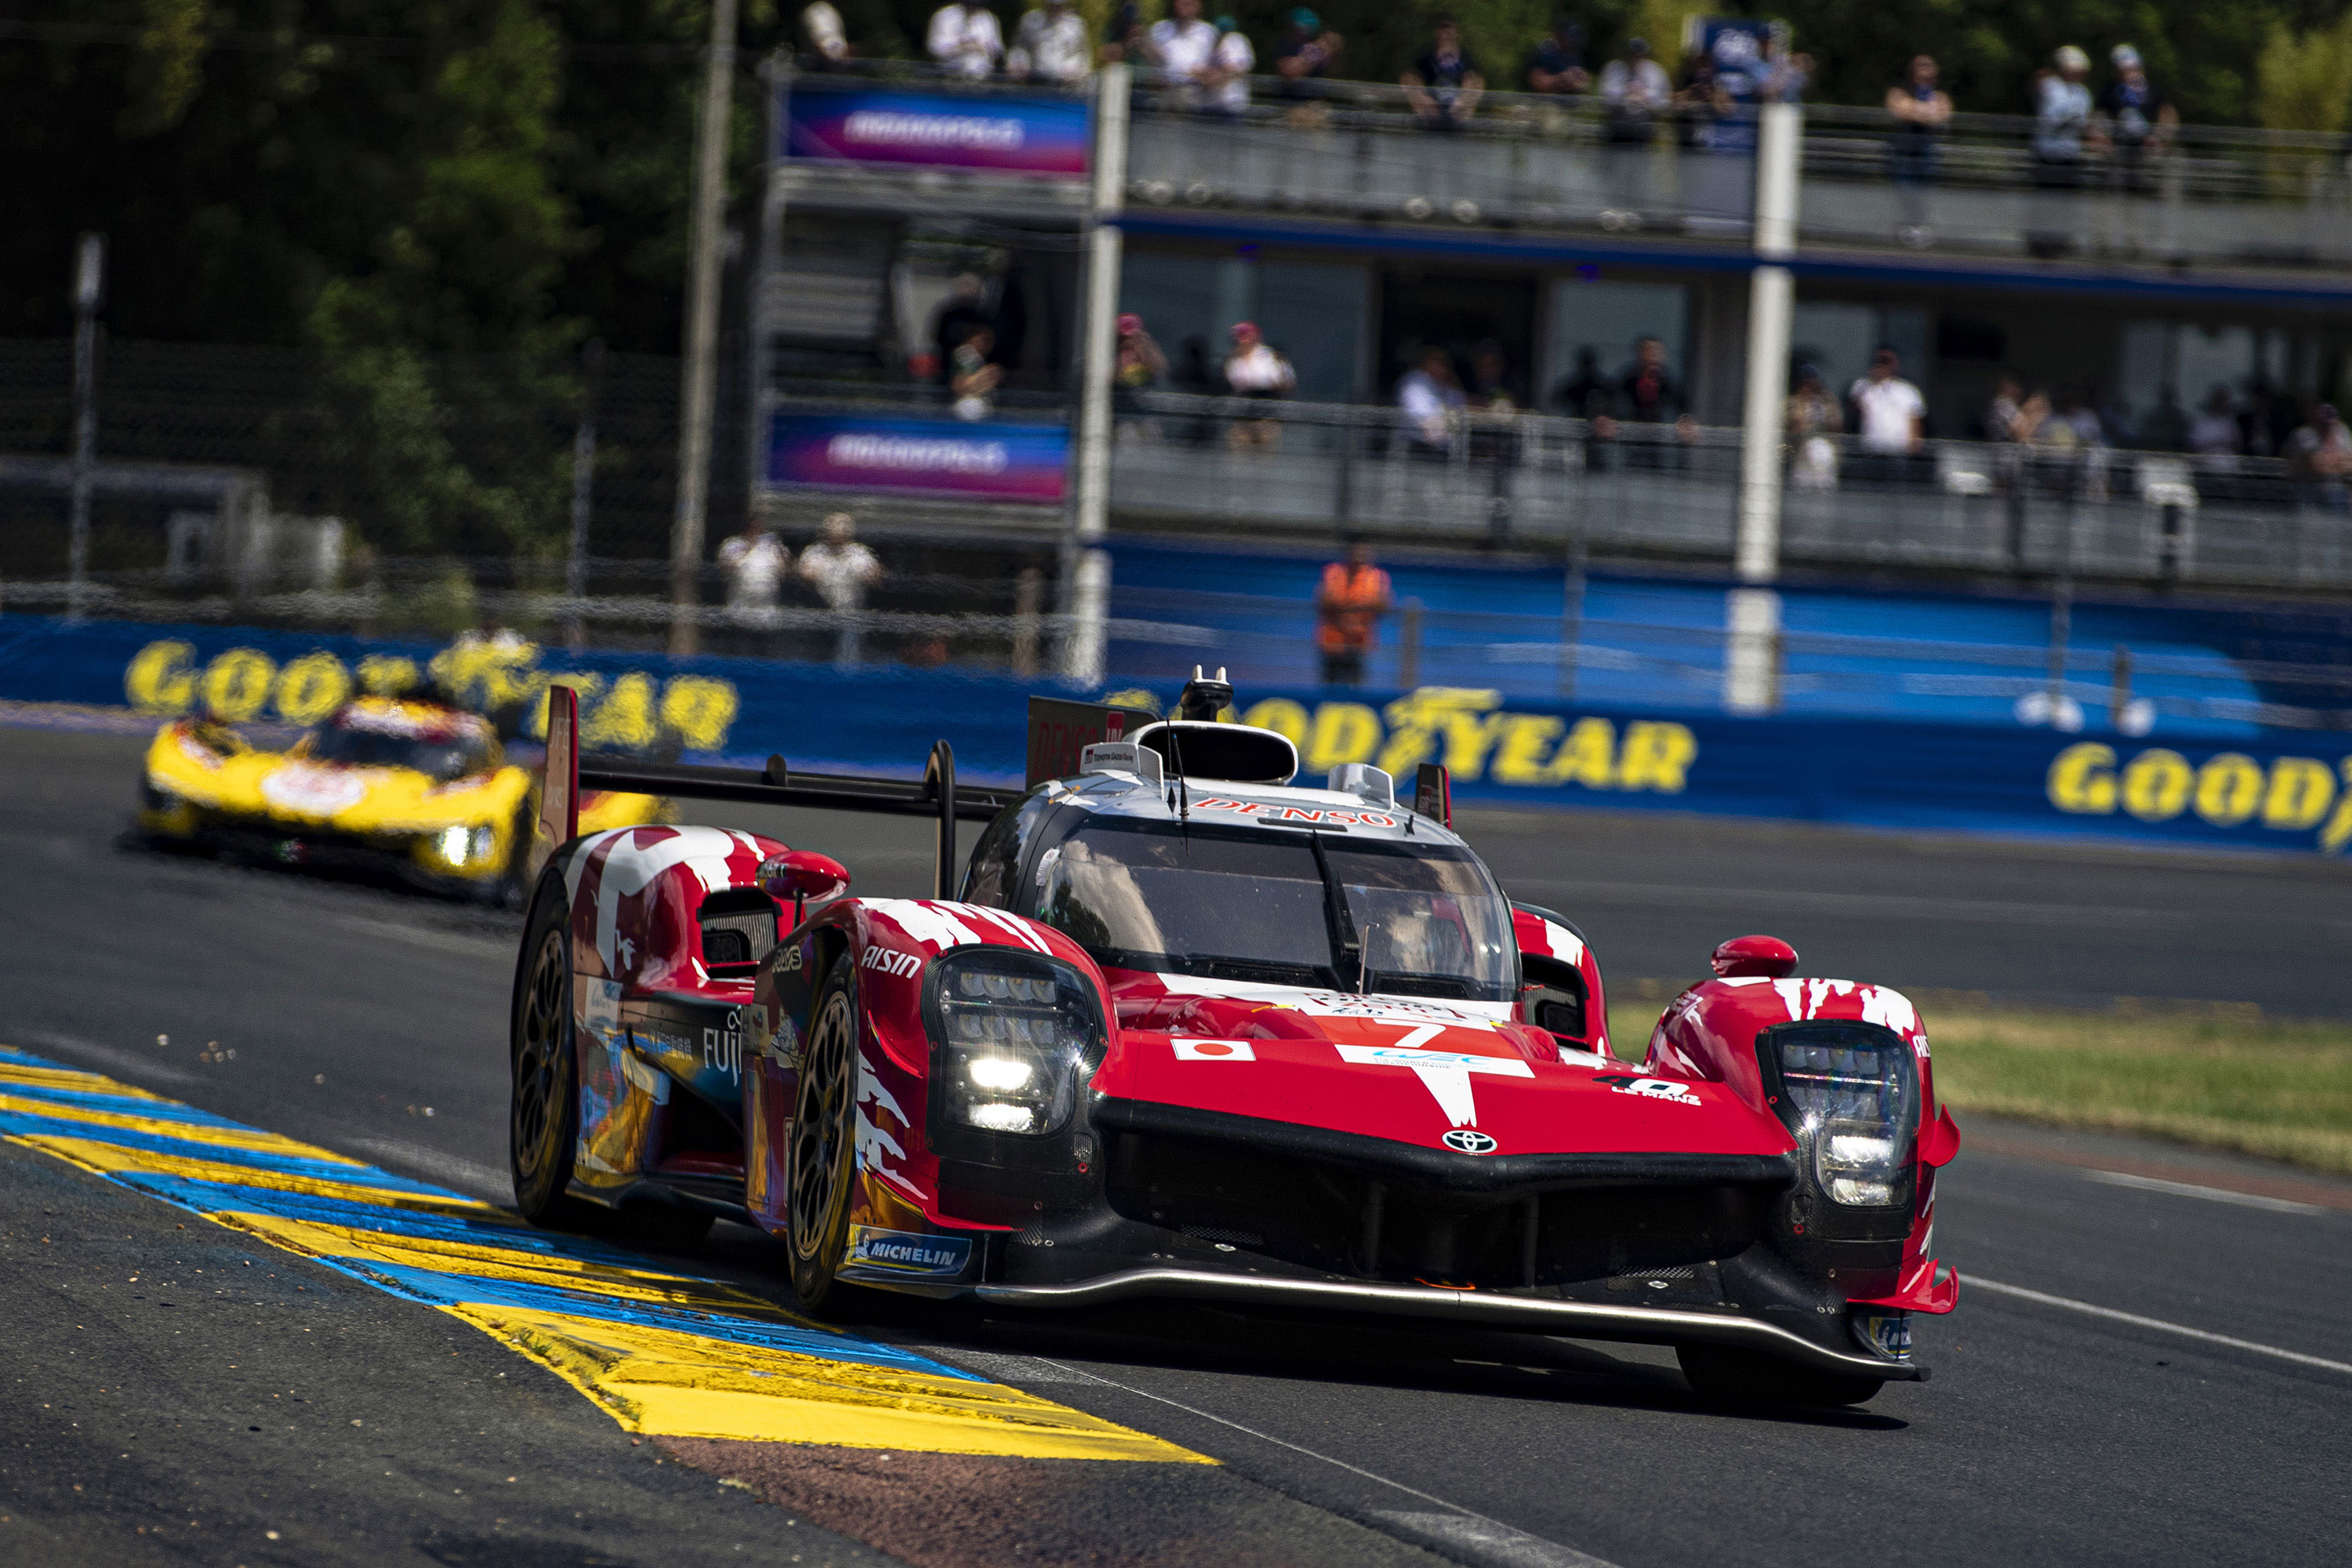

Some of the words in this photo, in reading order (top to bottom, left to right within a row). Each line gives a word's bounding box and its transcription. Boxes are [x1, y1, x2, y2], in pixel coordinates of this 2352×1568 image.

[1102, 687, 1697, 793] ODYEAR
[1192, 796, 1397, 829] DENSO
[2046, 740, 2352, 853] GOOD
[860, 946, 921, 979] AISIN
[1373, 1018, 1446, 1048] 7
[1611, 1086, 1638, 1095] LE
[1641, 1091, 1702, 1106] MANS
[870, 1242, 956, 1266] MICHELIN
